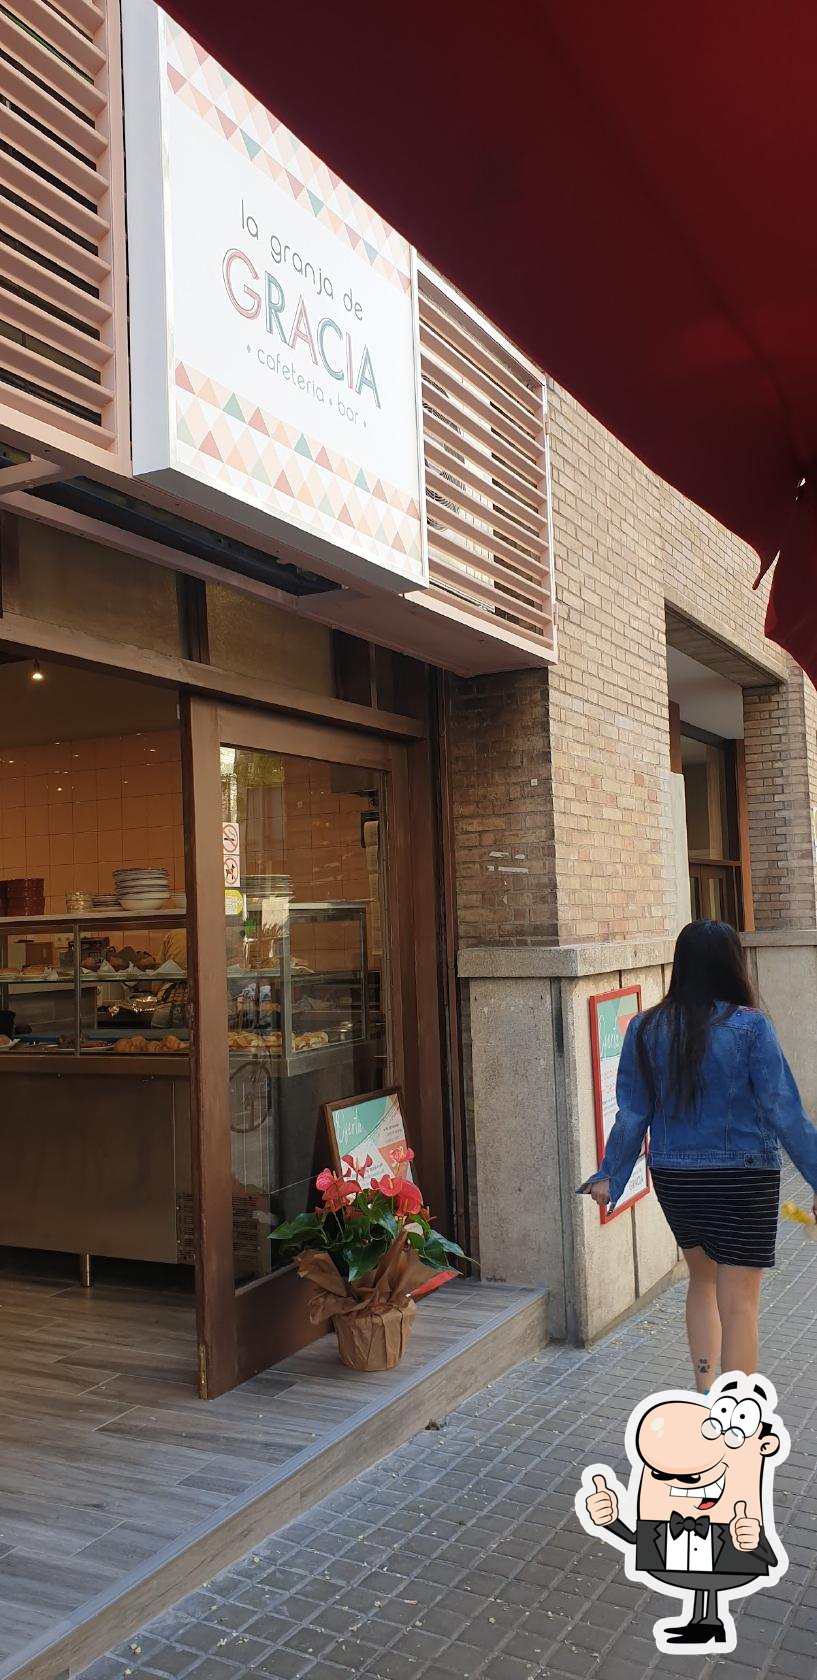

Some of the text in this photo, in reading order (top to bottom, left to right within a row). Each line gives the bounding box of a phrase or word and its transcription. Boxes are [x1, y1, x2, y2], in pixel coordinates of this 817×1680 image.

[241, 199, 363, 321] la granja de
[222, 247, 382, 410] GRACIA
[257, 348, 359, 425] cafeteria bar
